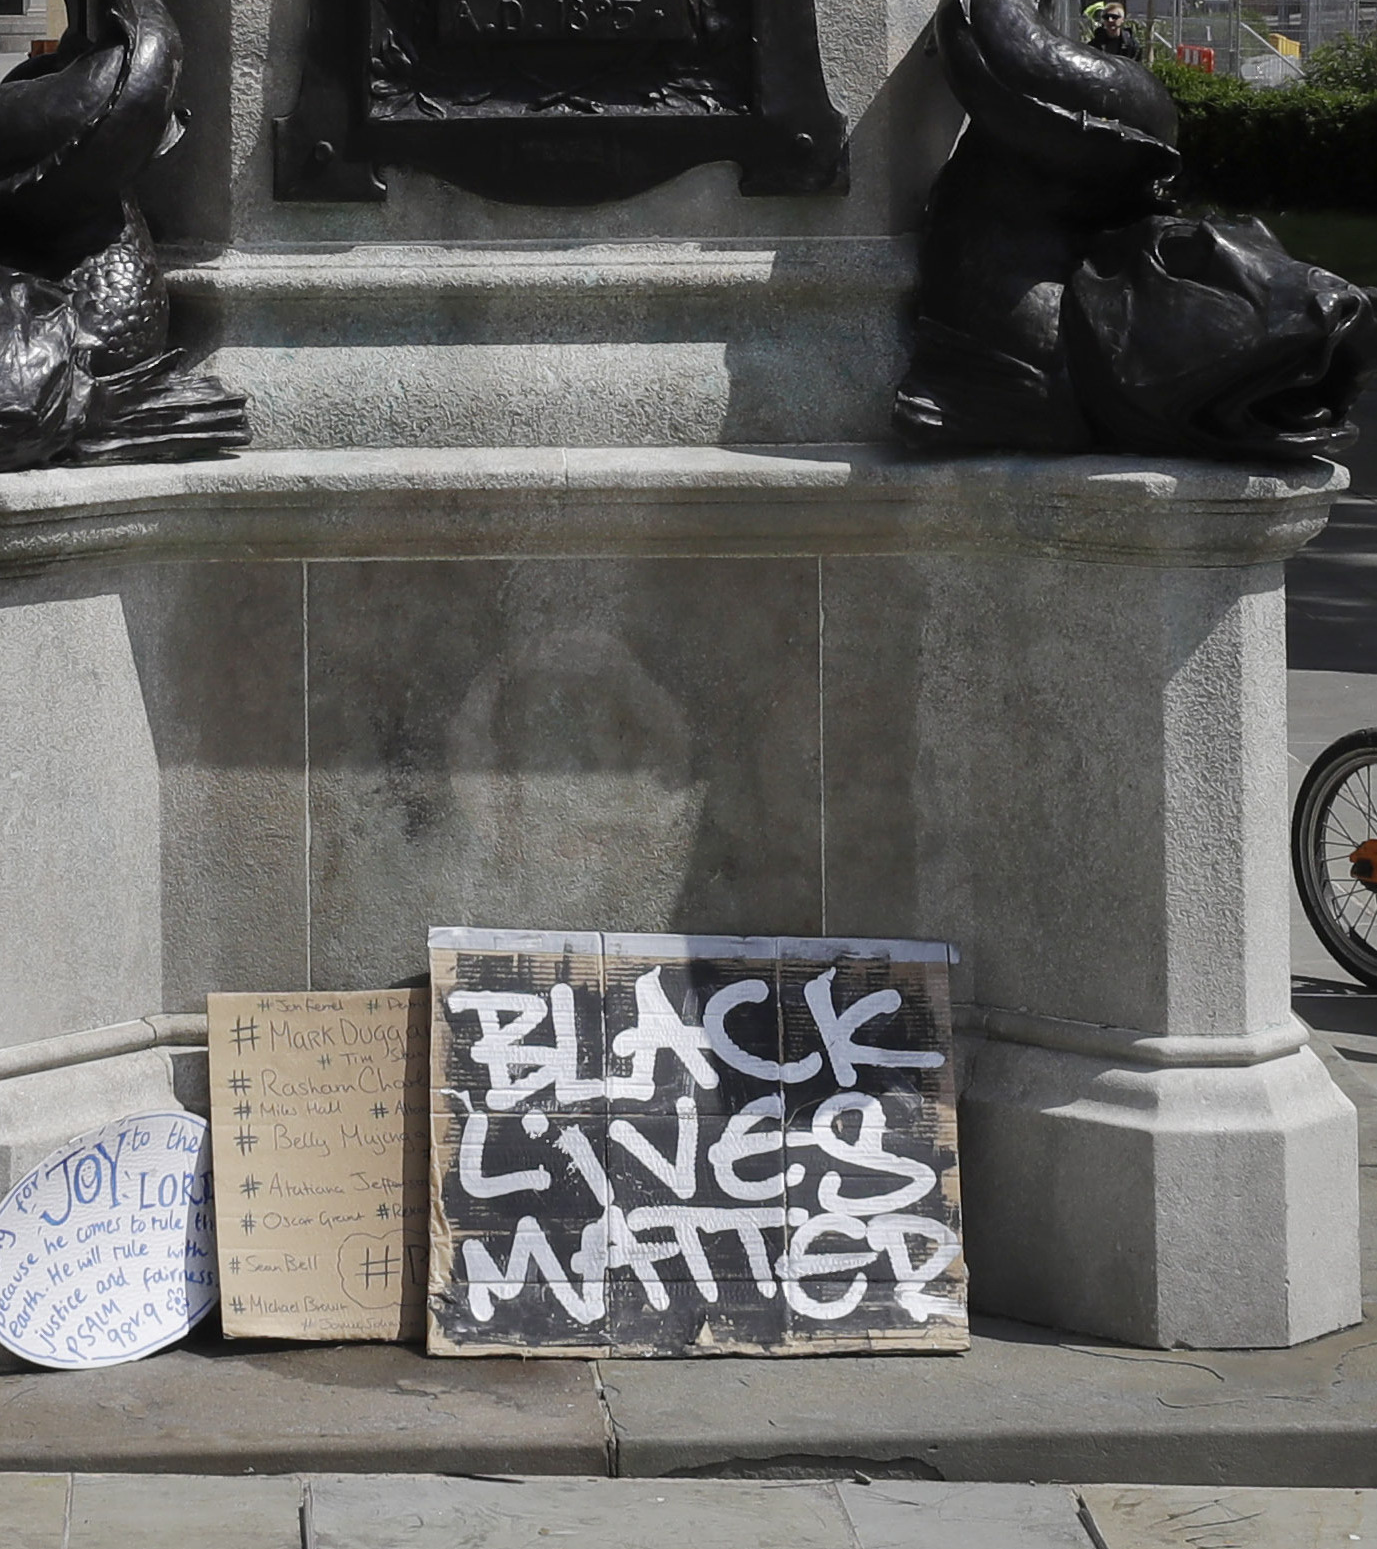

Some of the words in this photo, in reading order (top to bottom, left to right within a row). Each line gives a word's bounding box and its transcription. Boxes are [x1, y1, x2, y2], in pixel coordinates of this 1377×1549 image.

[447, 965, 947, 1112] BLACK
[14, 1170, 41, 1215] for
[38, 1127, 133, 1227] JOY
[131, 1125, 152, 1152] to
[166, 1121, 203, 1154] the
[43, 1235, 70, 1255] he
[76, 1216, 122, 1244] comes
[129, 1215, 146, 1234] to
[150, 1211, 185, 1231] rule
[194, 1211, 214, 1232] th
[47, 1261, 75, 1287] He
[76, 1244, 103, 1272] will
[112, 1239, 150, 1261] rule
[166, 1238, 209, 1259] with
[462, 1205, 968, 1324] MATTER
[34, 1287, 89, 1355] justice
[95, 1266, 130, 1295] and
